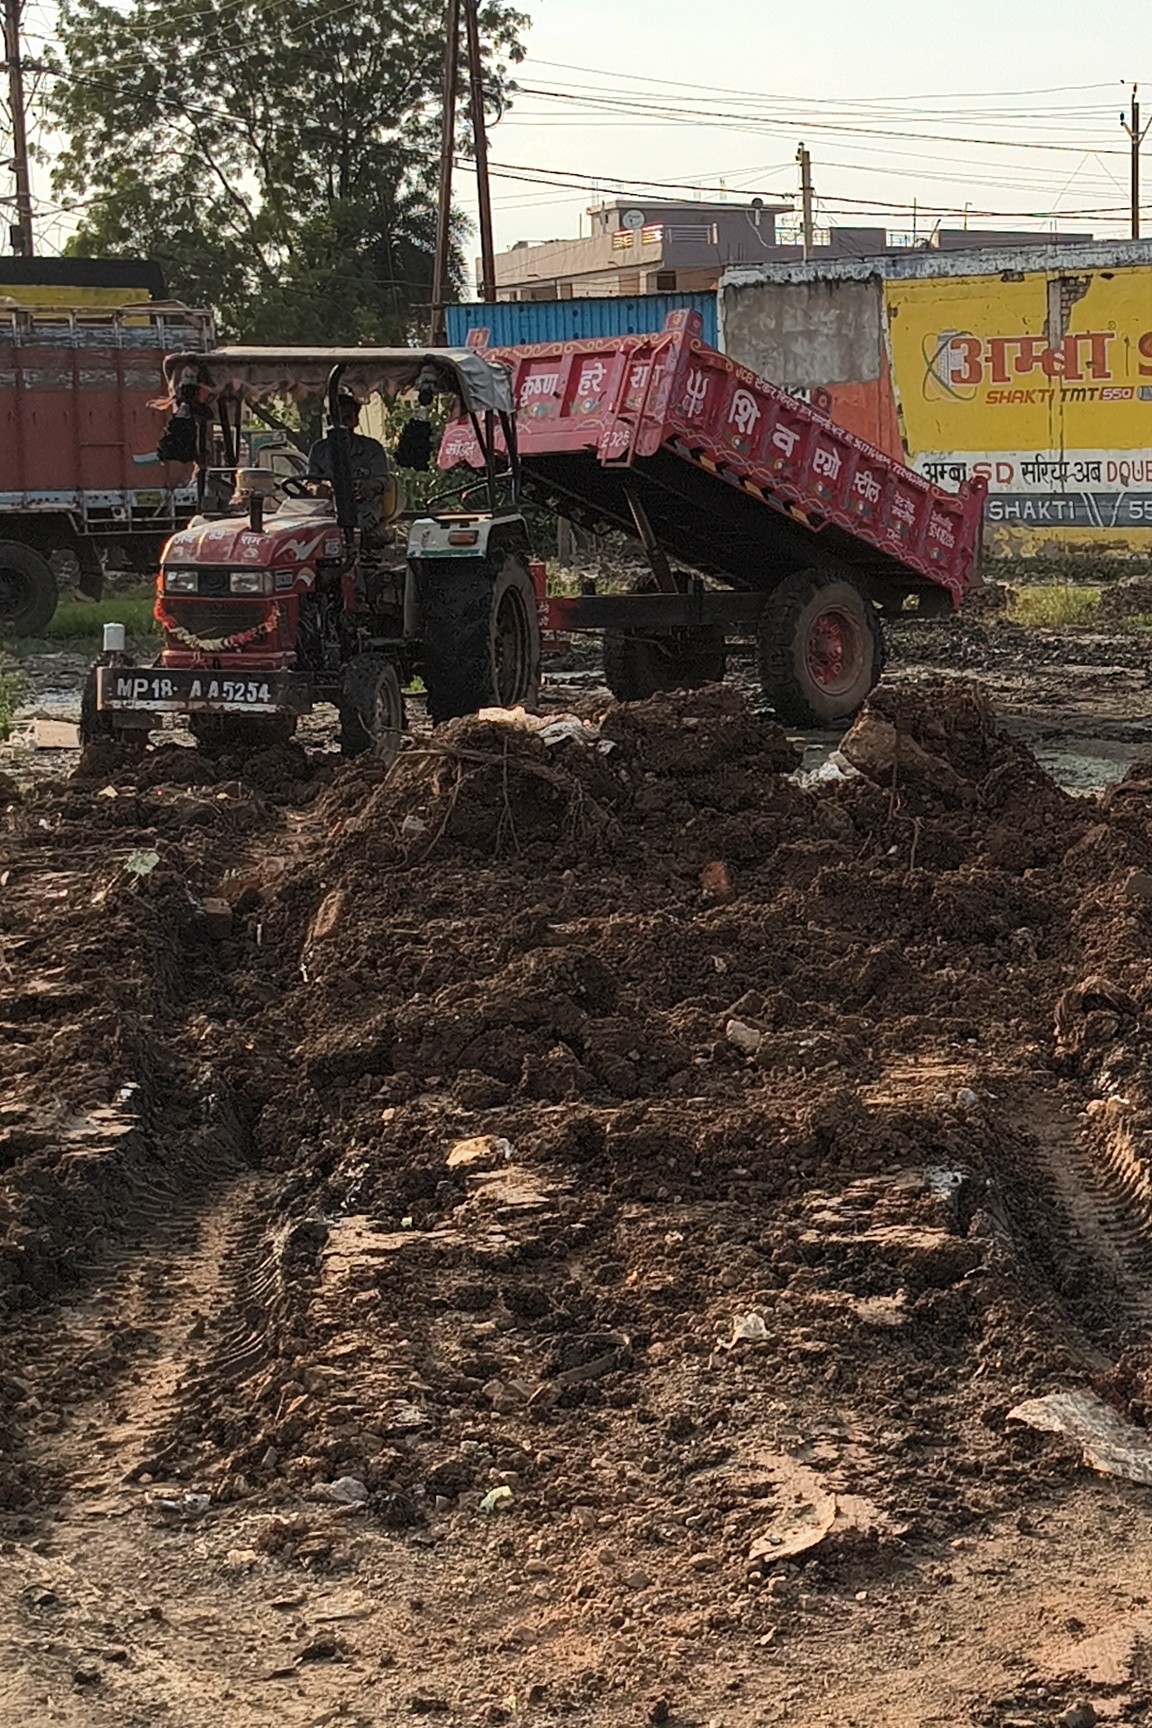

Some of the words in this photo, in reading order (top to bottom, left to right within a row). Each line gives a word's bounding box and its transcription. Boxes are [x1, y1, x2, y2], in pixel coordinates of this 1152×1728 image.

[578, 363, 607, 396] हरे
[986, 389, 1055, 404] SHAKTI
[1060, 387, 1098, 403] TMT
[921, 462, 967, 485] अम्बा
[972, 462, 1015, 484] SD
[988, 500, 1076, 520] SHAKTI
